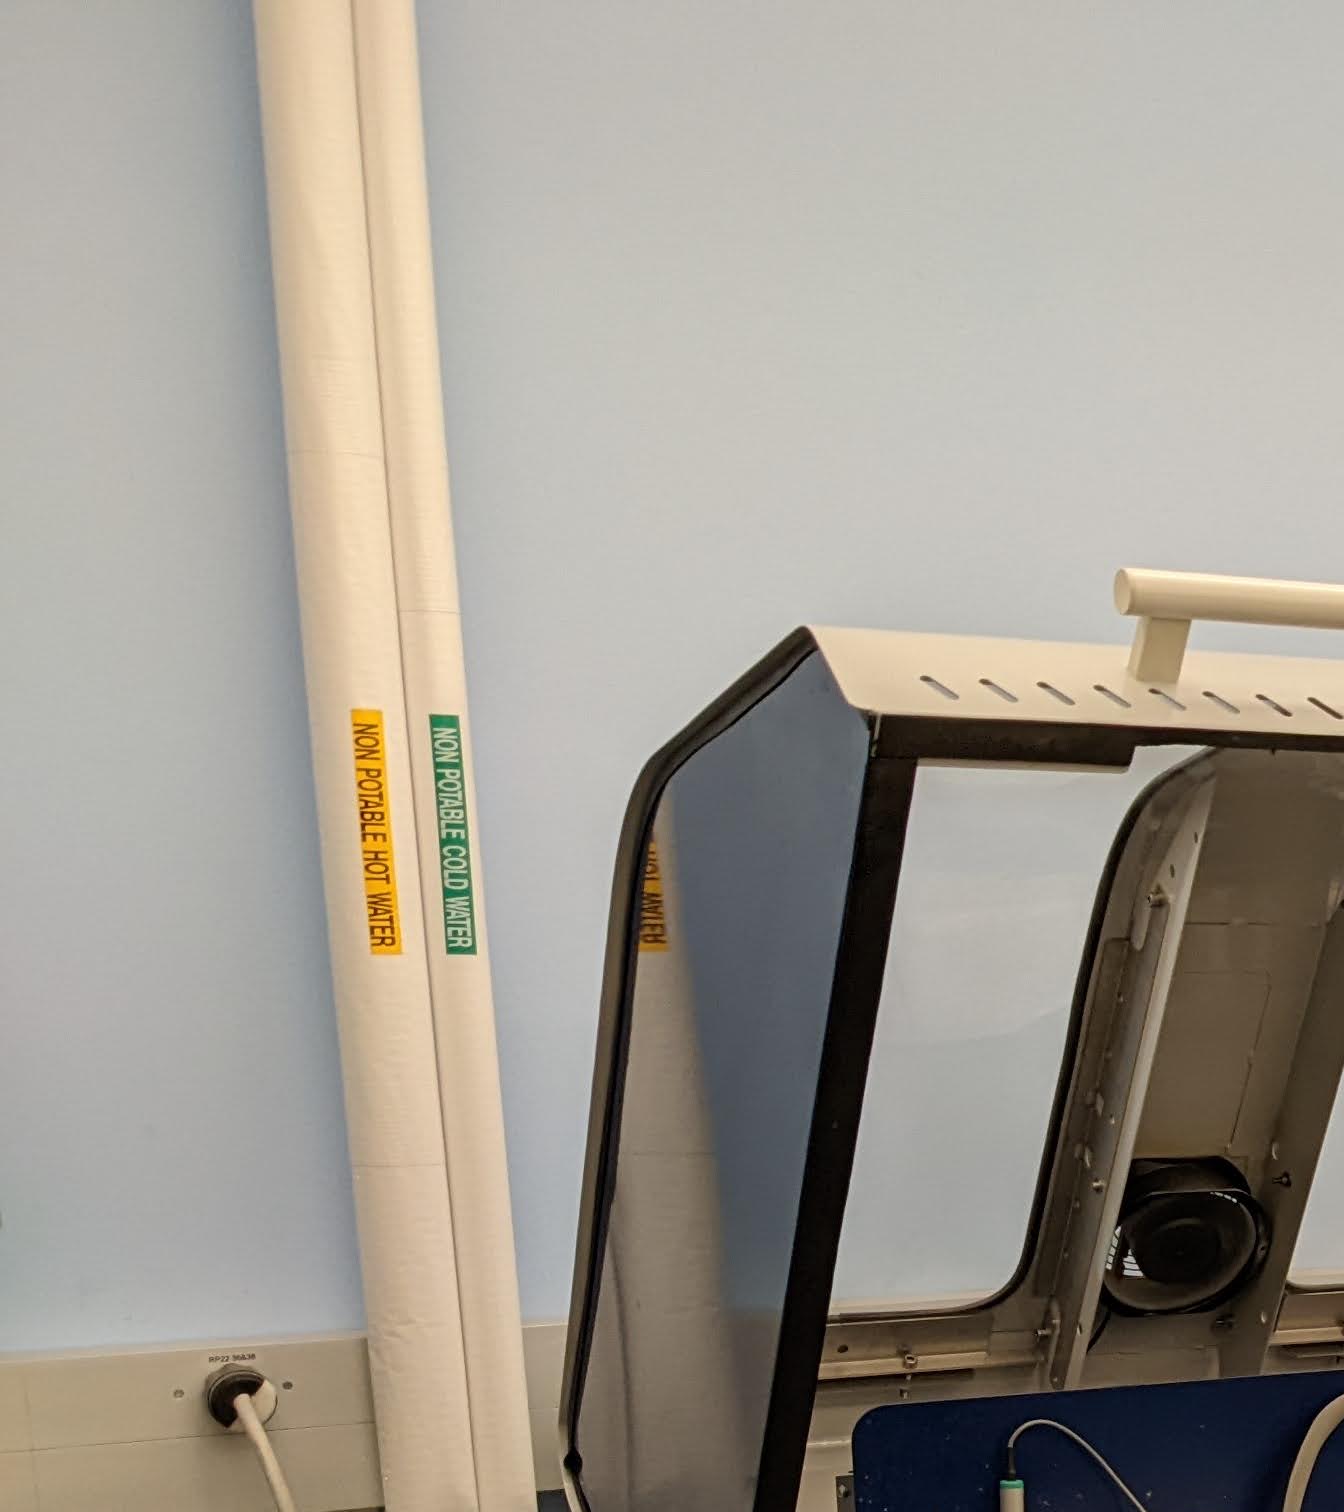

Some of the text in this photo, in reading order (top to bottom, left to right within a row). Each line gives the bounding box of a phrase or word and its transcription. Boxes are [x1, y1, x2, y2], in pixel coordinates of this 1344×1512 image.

[353, 723, 396, 948] NON POTABLE HOT WATER
[433, 727, 473, 949] NON POTABLE COLD WATER
